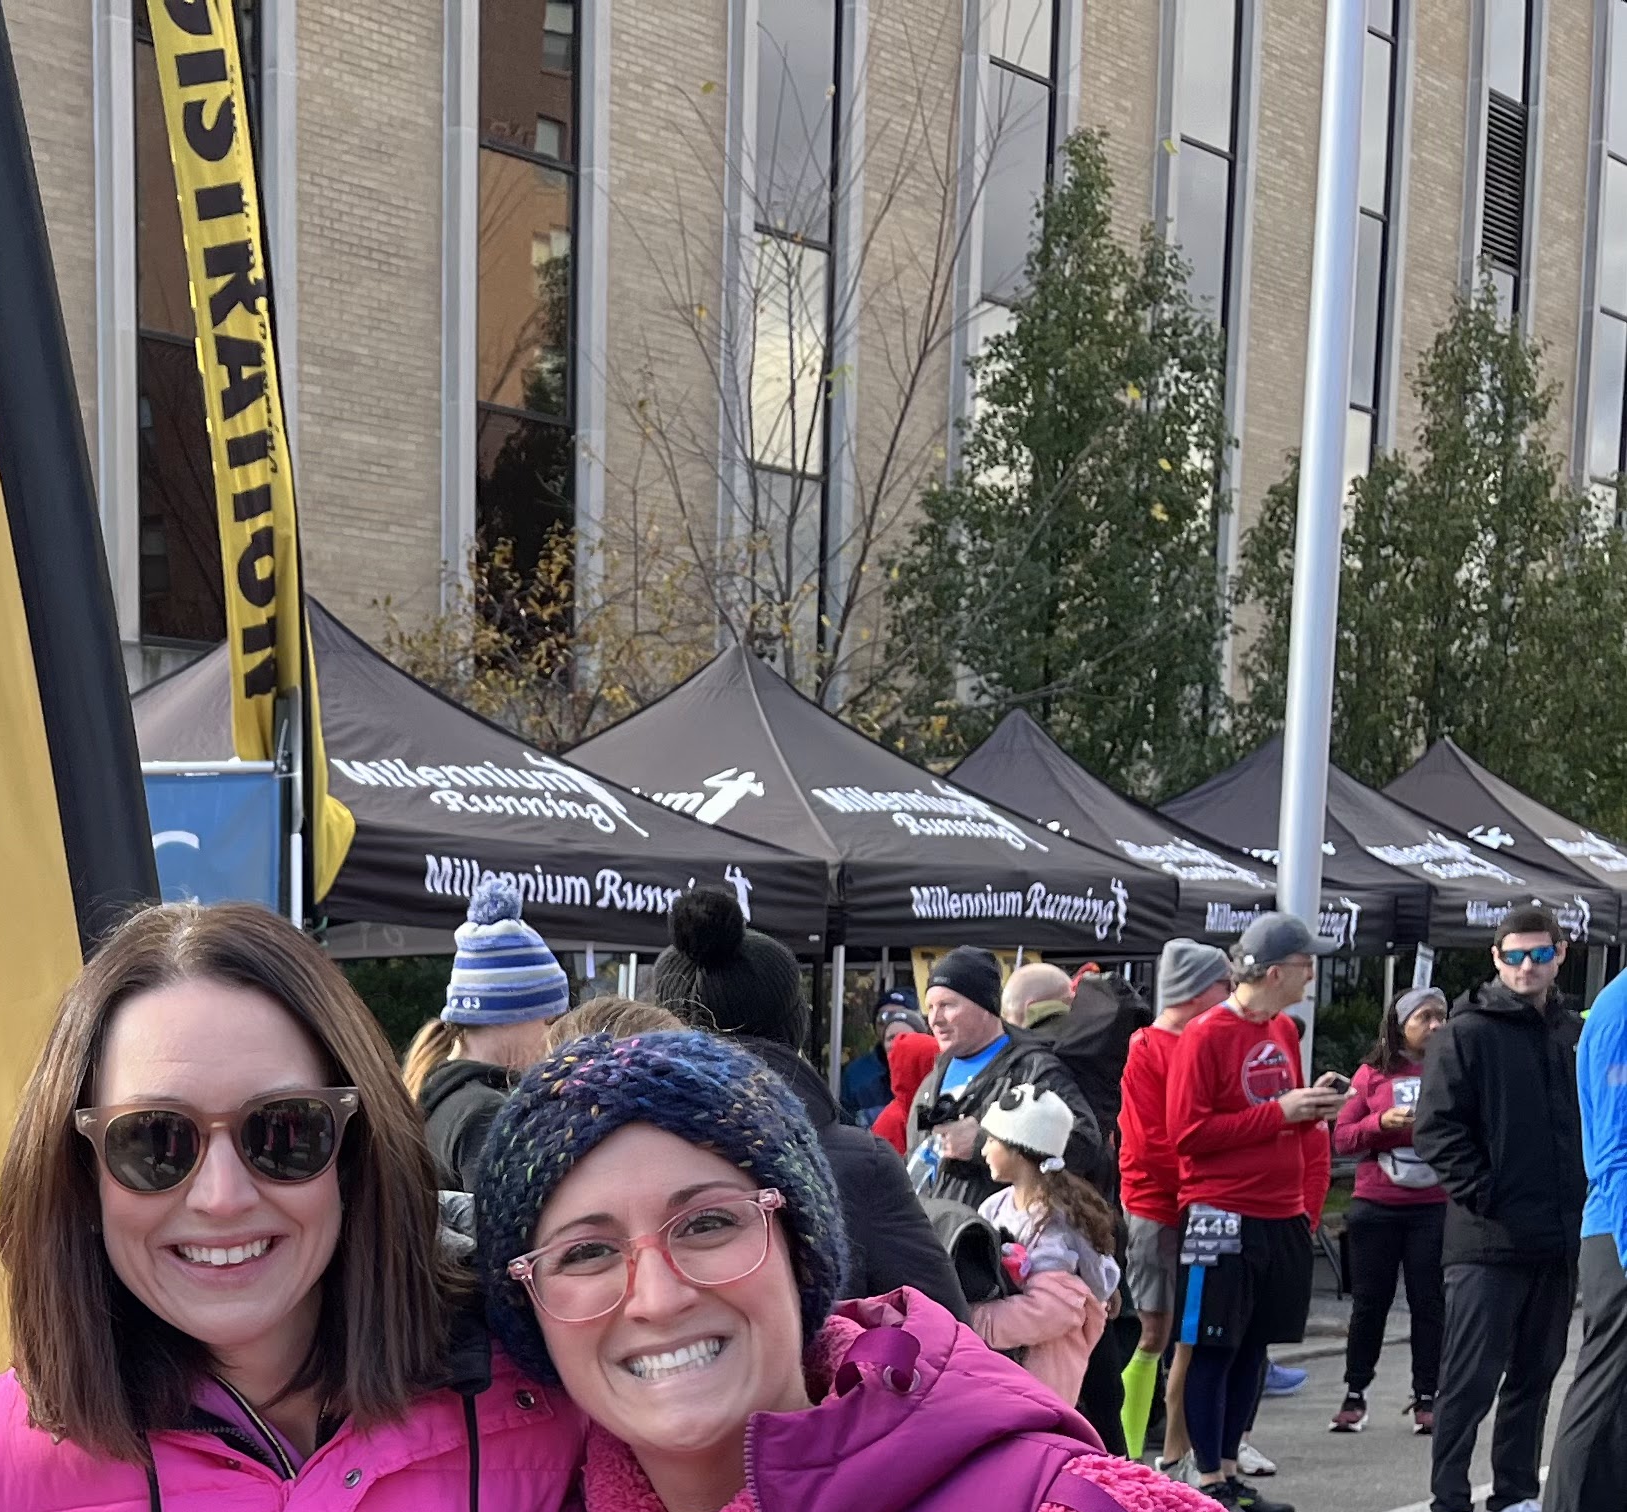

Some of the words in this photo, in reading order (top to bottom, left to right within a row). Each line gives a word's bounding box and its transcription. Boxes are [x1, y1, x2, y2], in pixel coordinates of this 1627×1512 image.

[330, 758, 582, 793] Millennium
[430, 789, 617, 834] Running
[811, 785, 984, 815] Millennium
[892, 812, 1028, 851] Running
[910, 885, 1024, 920] Millennium
[1025, 881, 1116, 941] Running
